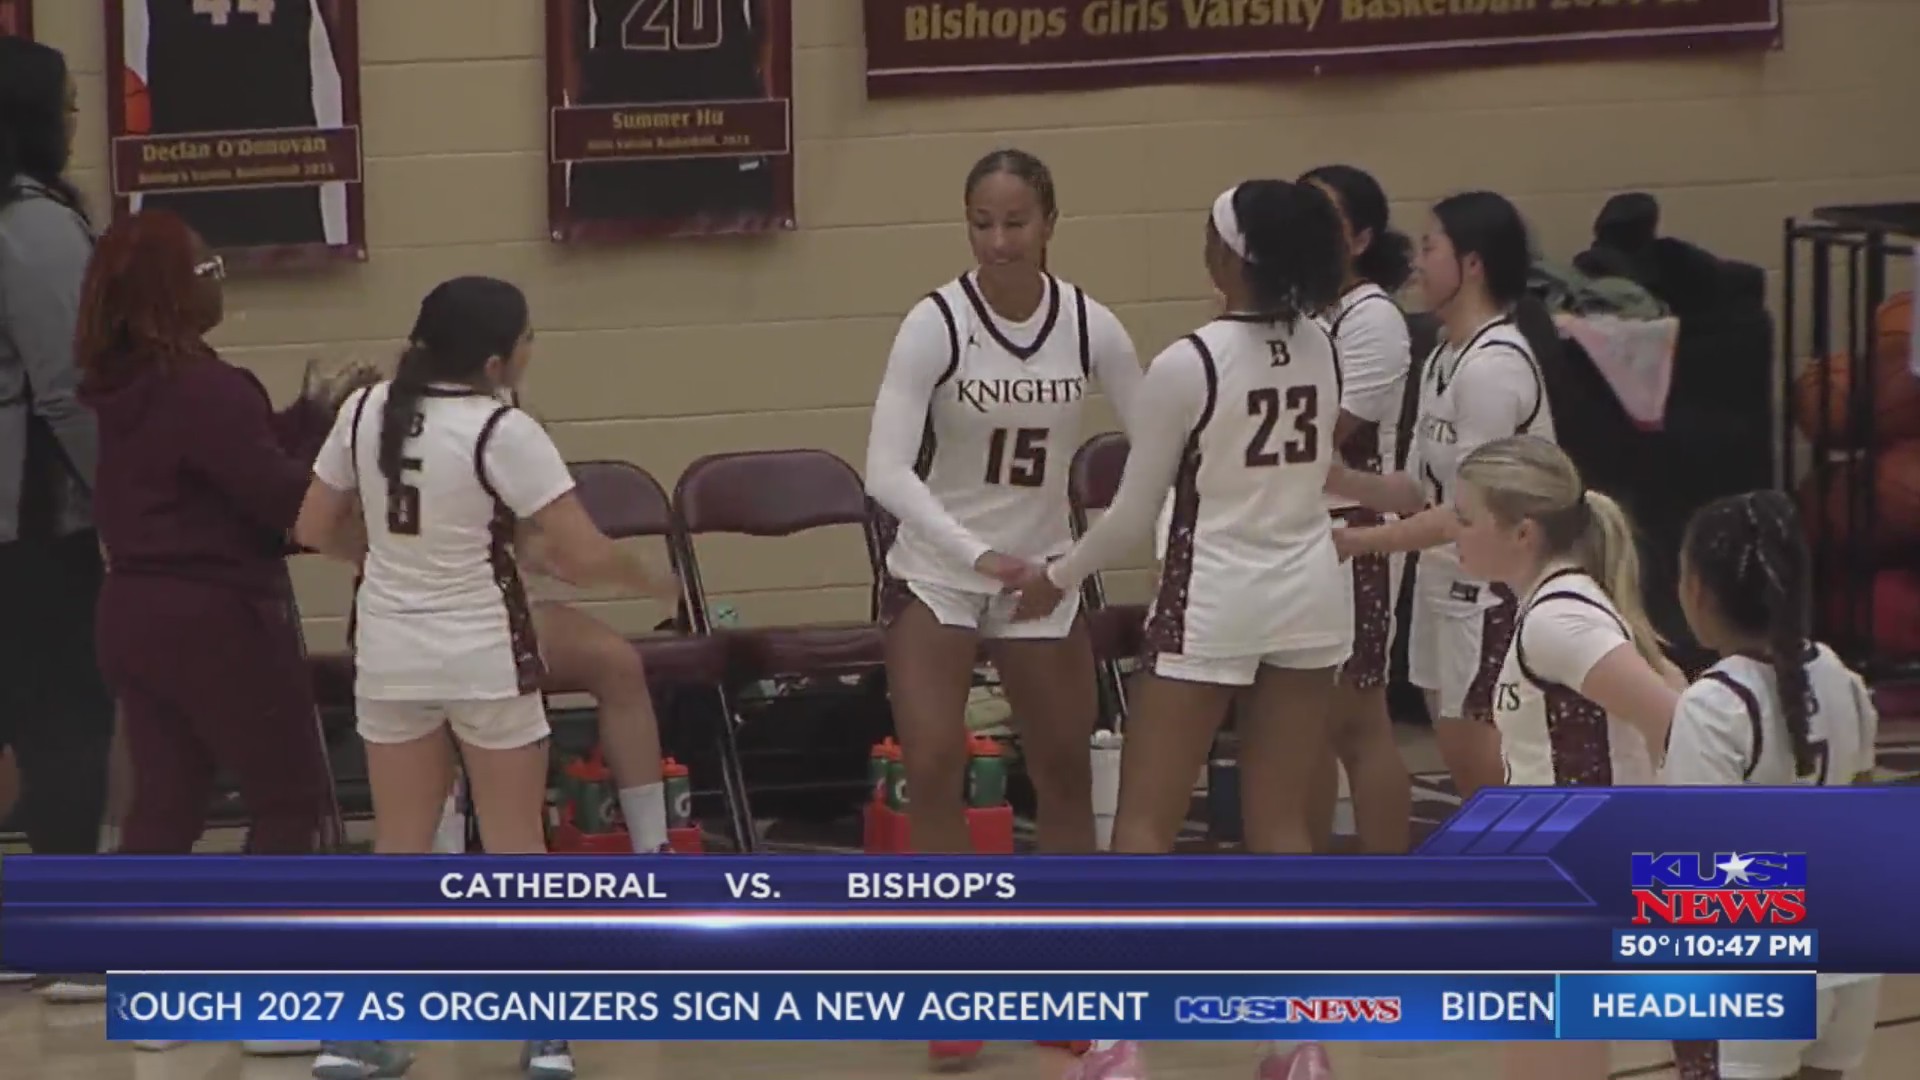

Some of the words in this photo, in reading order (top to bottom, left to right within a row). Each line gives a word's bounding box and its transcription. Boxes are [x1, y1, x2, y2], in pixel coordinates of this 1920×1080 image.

[903, 4, 1067, 45] Bishops
[1081, 0, 1168, 35] Girls
[1181, 0, 1324, 32] Varsity
[611, 111, 689, 130] Summer
[142, 141, 211, 162] Declan
[1265, 338, 1292, 368] B
[956, 376, 1083, 414] KNIGHTS
[1244, 383, 1319, 468] 23
[984, 426, 1051, 488] 15
